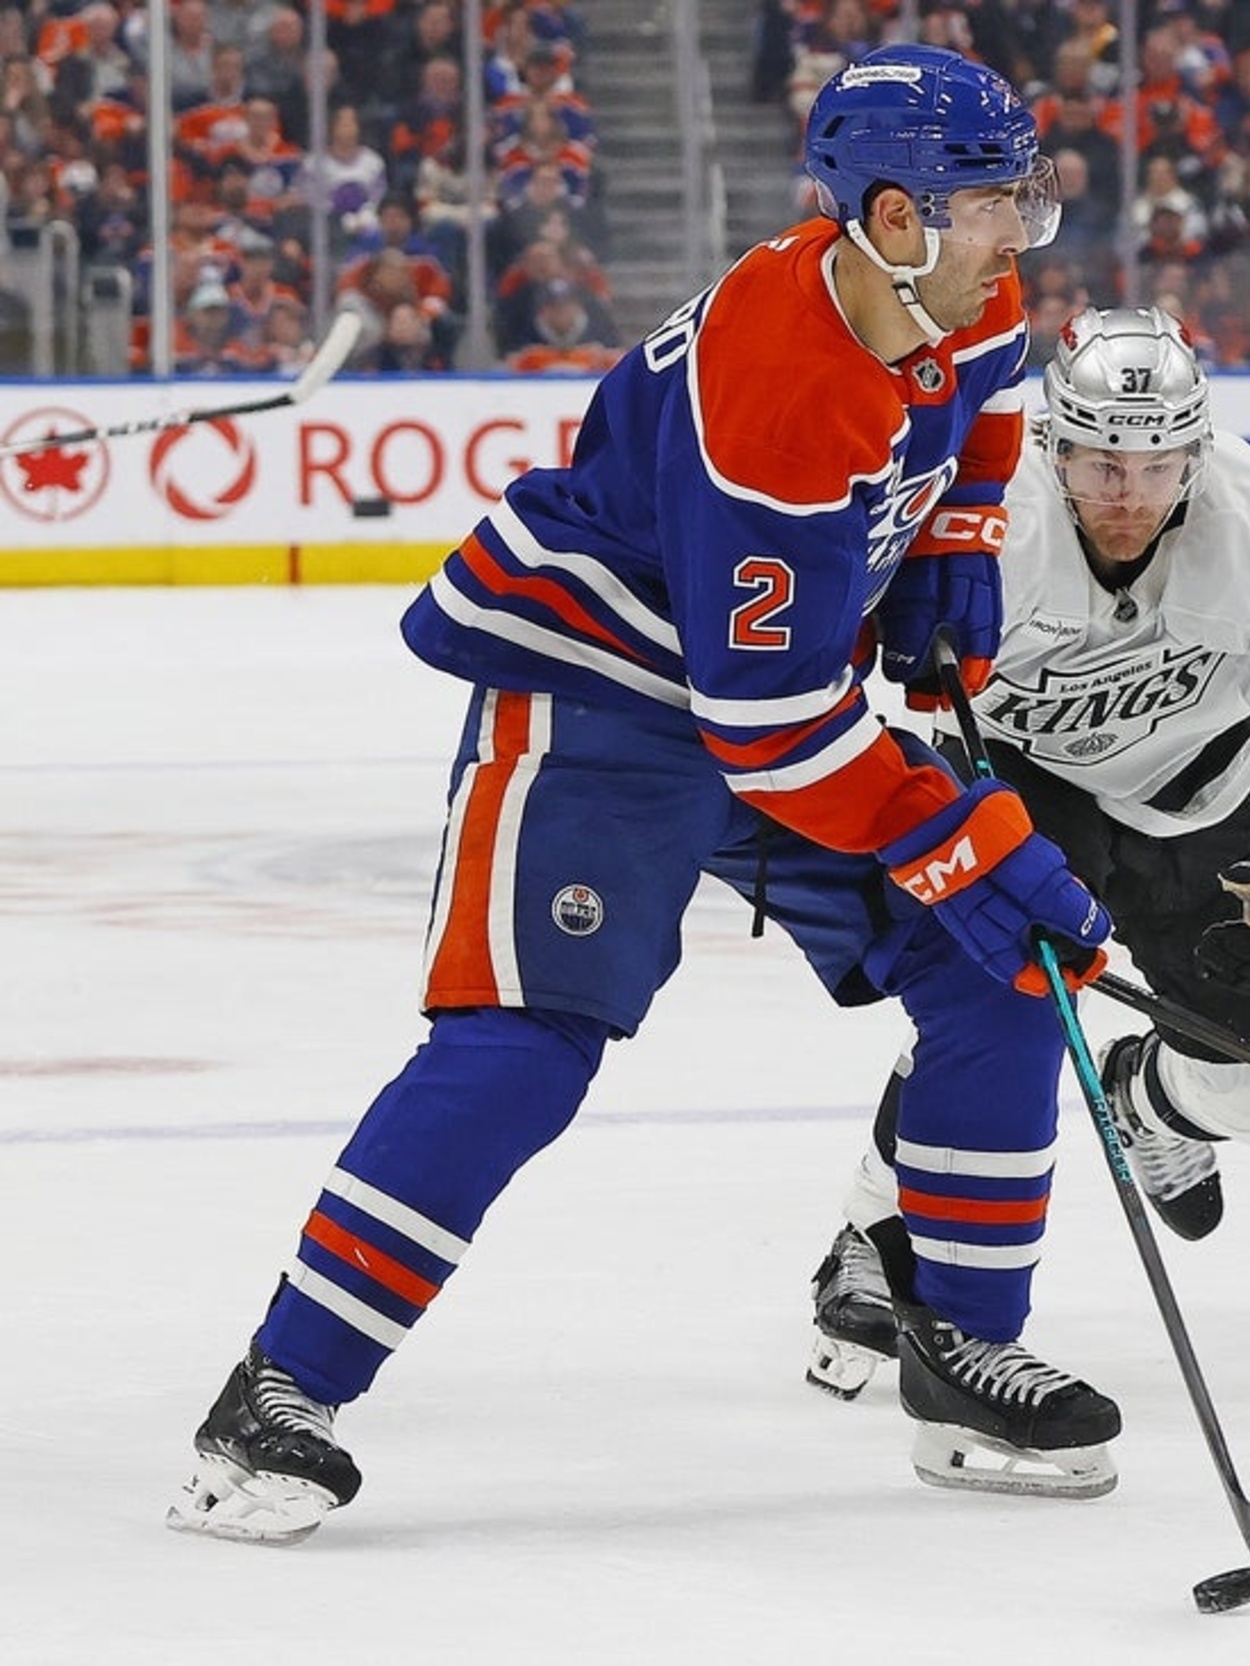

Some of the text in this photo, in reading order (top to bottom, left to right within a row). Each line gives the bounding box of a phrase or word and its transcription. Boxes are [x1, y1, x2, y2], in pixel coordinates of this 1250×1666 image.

[1121, 368, 1152, 393] 37
[1108, 415, 1165, 426] CCM
[728, 555, 795, 651] 2
[985, 652, 1212, 734] KINGS
[1060, 661, 1153, 694] Los Angeles
